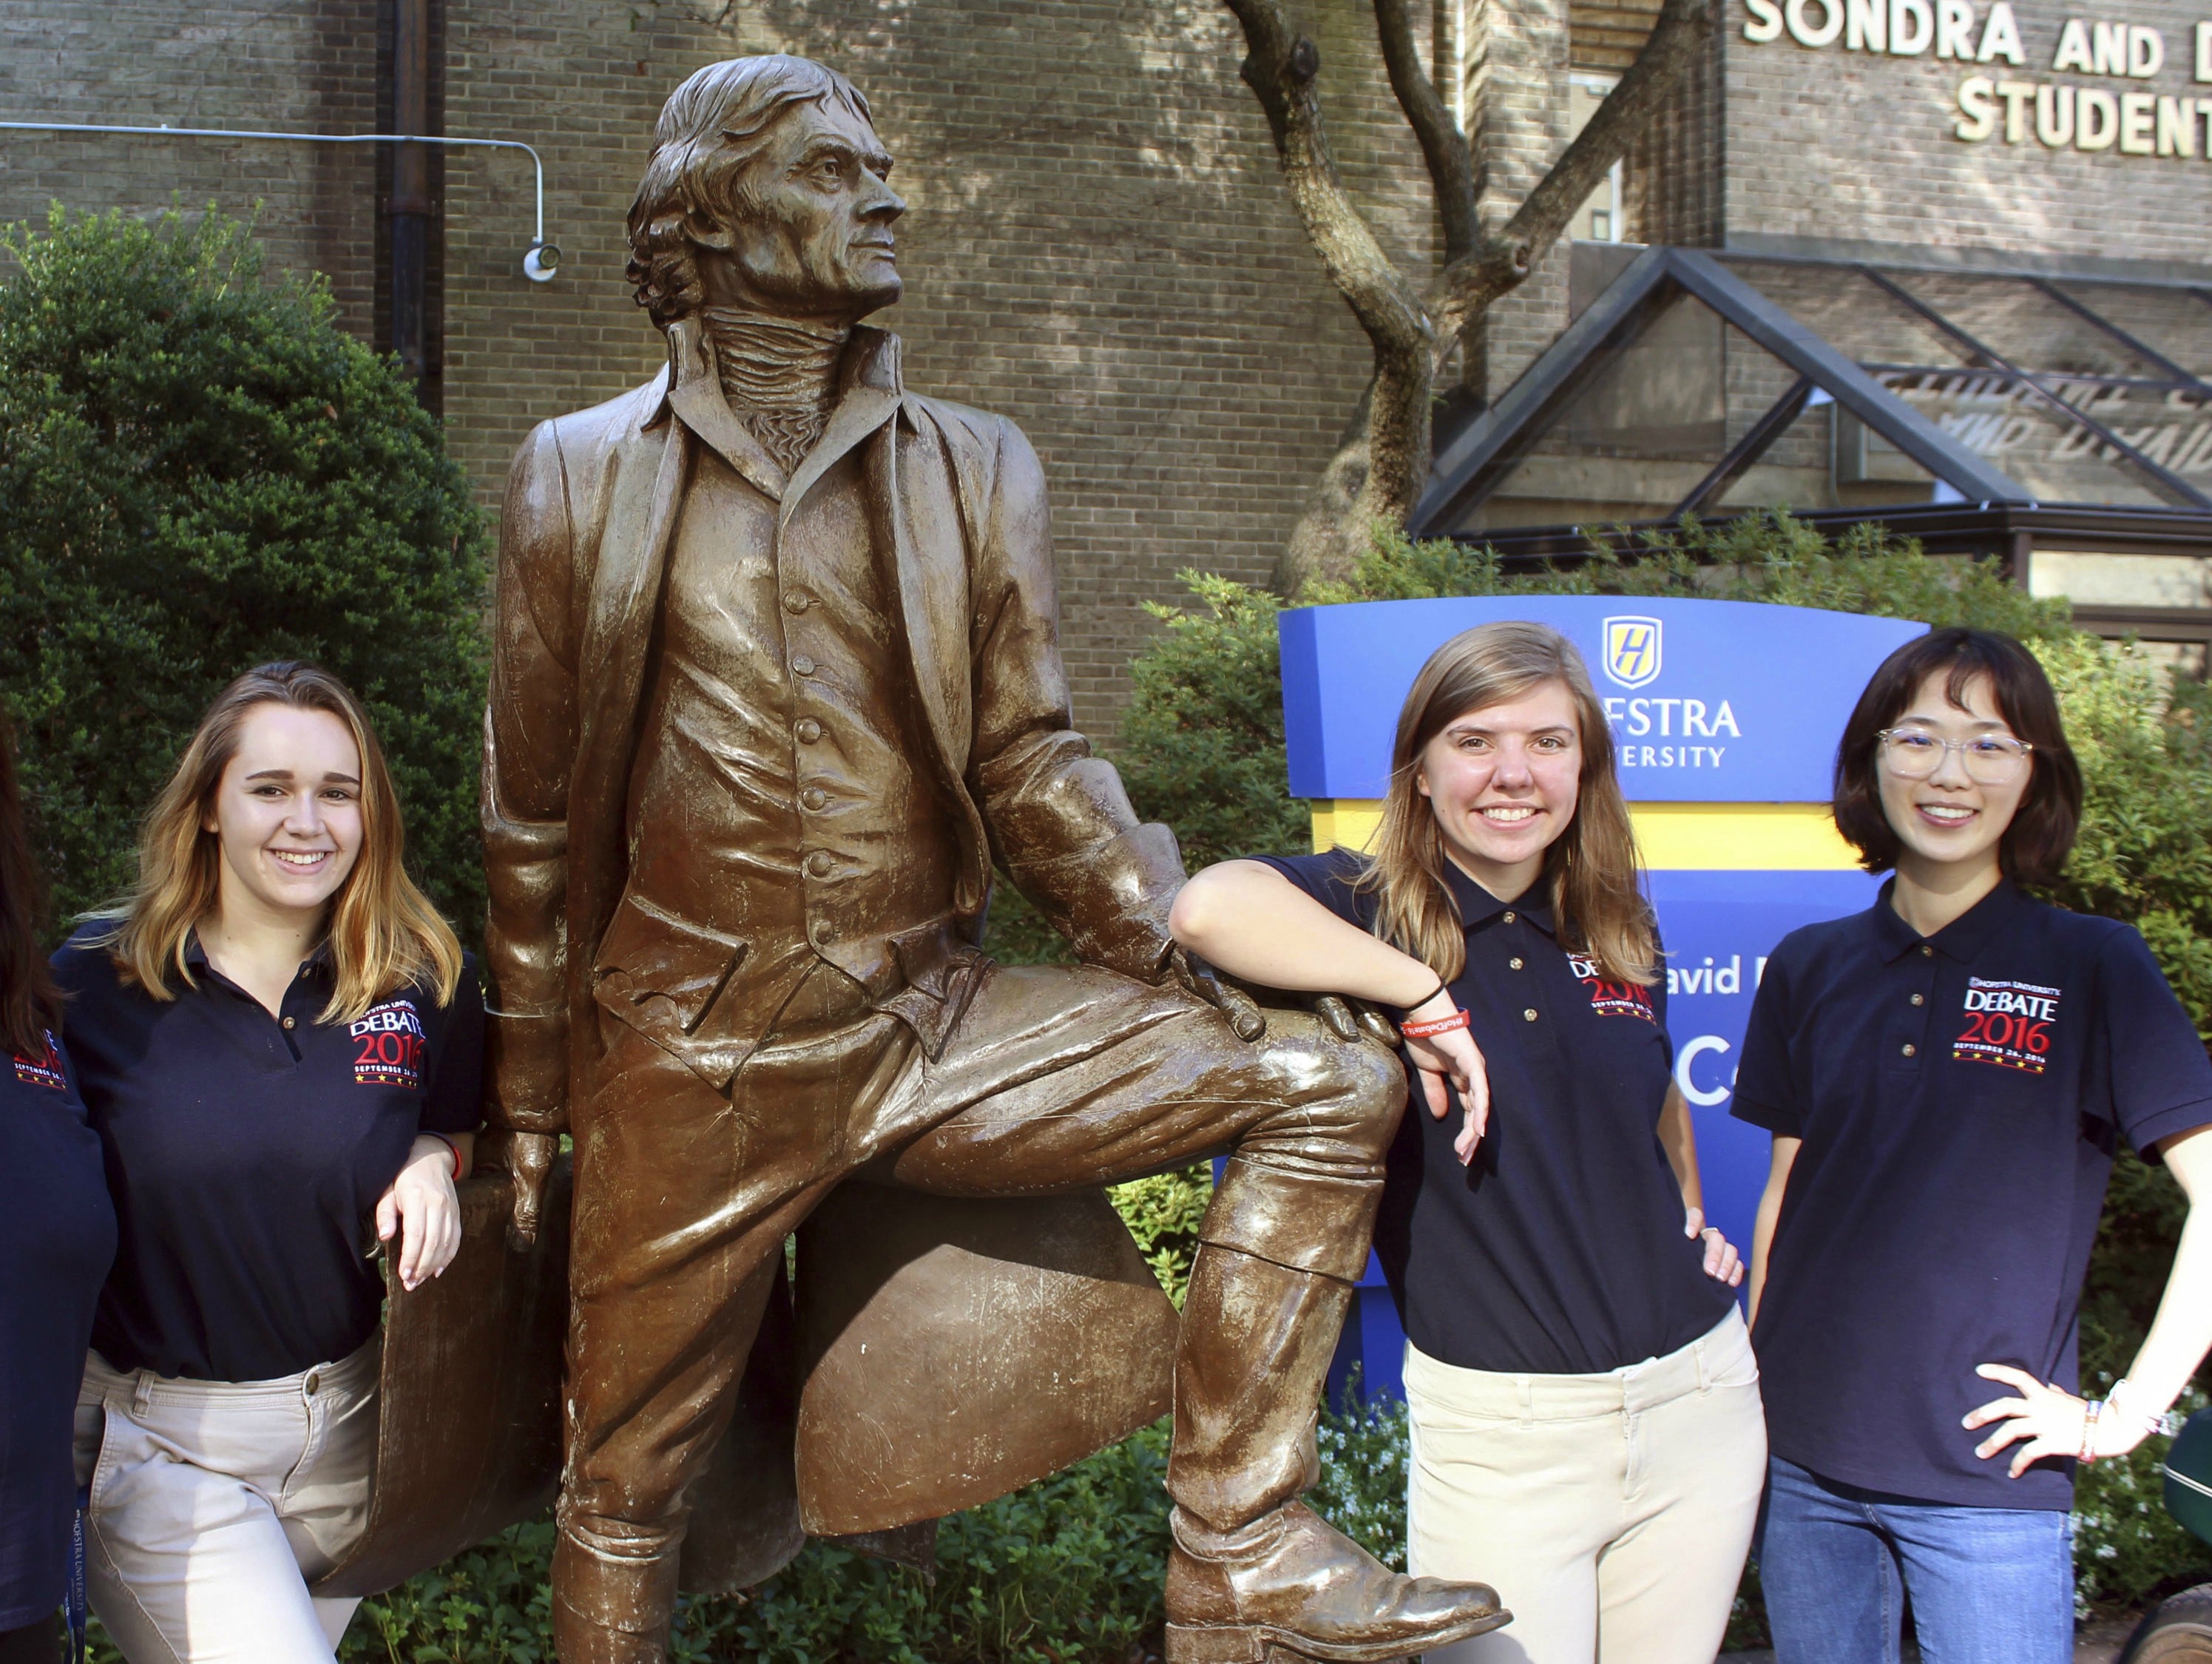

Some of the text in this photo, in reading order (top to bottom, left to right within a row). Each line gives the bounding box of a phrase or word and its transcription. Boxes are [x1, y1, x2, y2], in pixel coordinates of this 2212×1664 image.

[1743, 0, 2026, 64] SONDRA
[2053, 19, 2165, 78] AND
[1603, 697, 1742, 737] FSTRA
[1617, 745, 1725, 768] ERSITY
[1667, 954, 1740, 994] avid
[1964, 989, 2058, 1022] DEBATE
[350, 1010, 426, 1039] DEBATE
[1956, 1012, 2051, 1055] 2016
[353, 1032, 425, 1069] 2016
[1953, 1042, 2003, 1054] SEPTEMBER
[355, 1065, 401, 1074] SEPTEMBER
